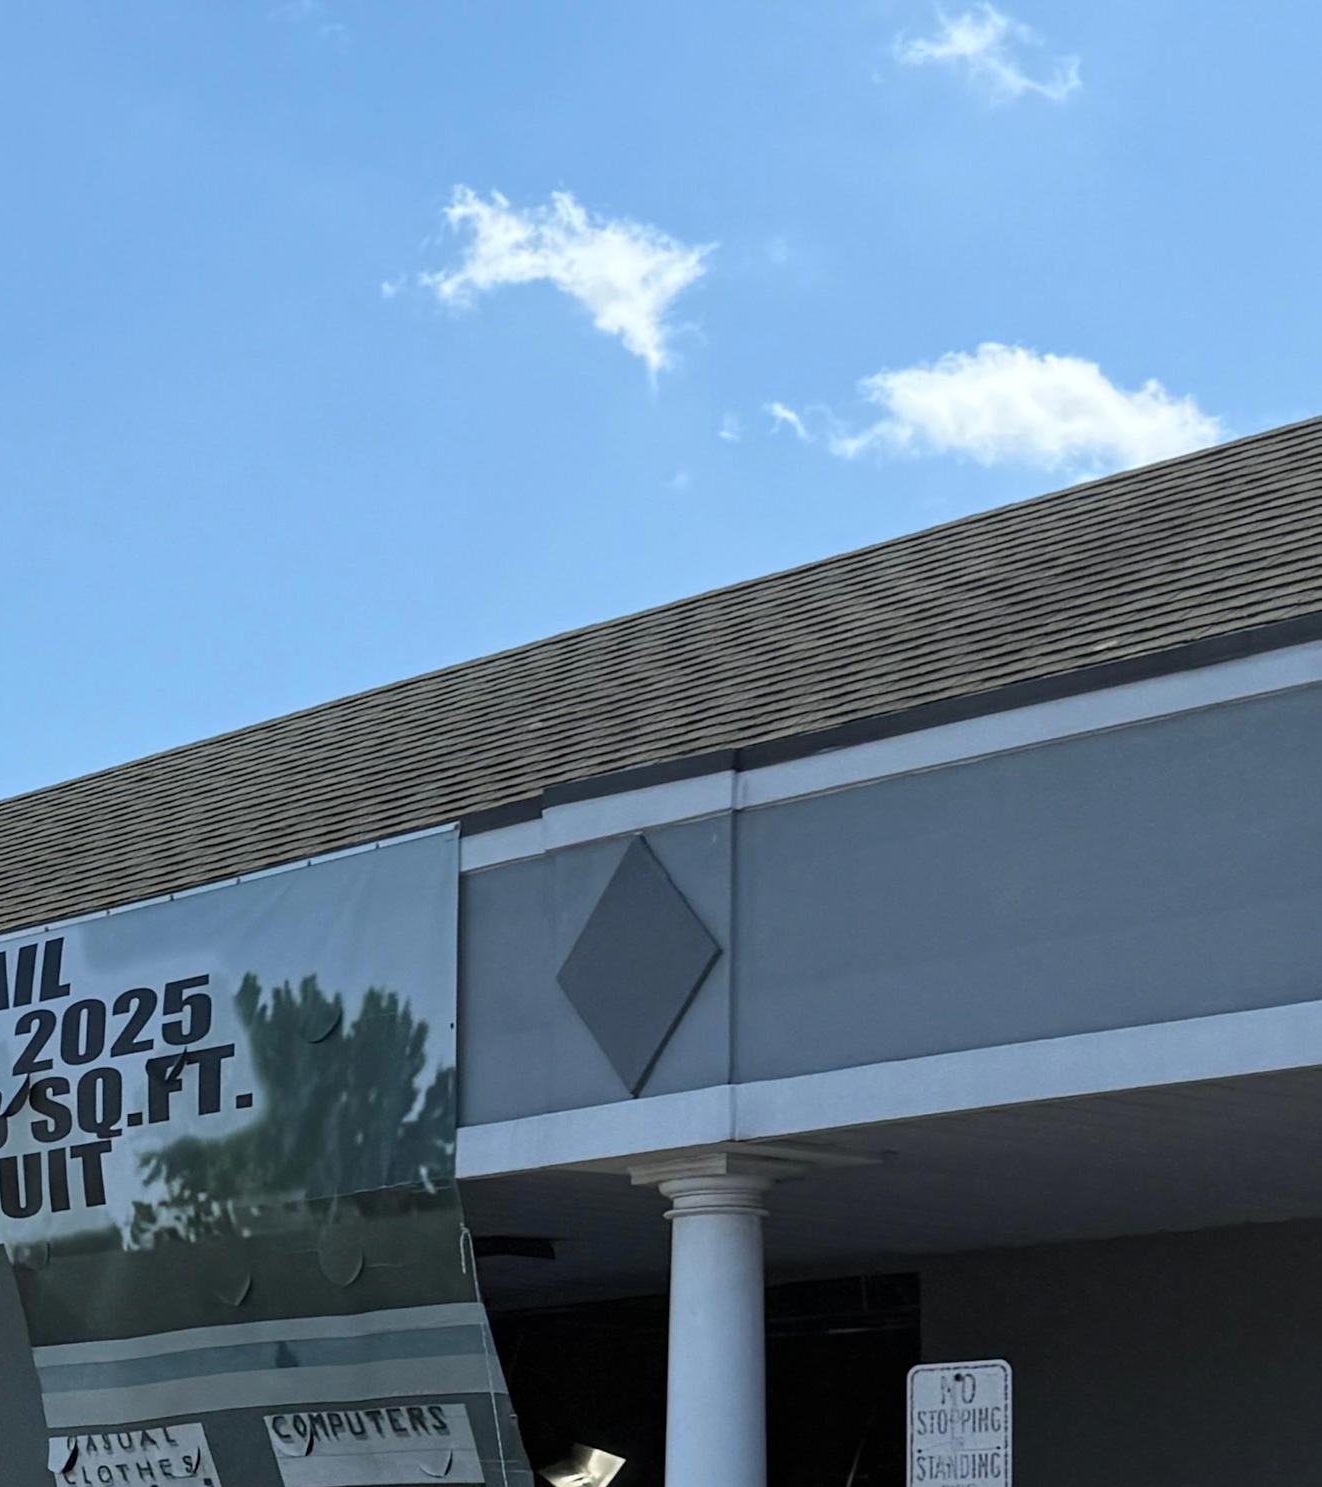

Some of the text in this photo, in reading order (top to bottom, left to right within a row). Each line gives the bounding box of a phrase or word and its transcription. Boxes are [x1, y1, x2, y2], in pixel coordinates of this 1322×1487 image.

[12, 974, 212, 1076] 2025
[30, 1044, 254, 1143] SQ.FT.
[941, 1373, 976, 1405] NO
[271, 1406, 450, 1442] COMPUTERS
[917, 1407, 1001, 1435] STOPPING
[916, 1453, 1001, 1481] STANDING
